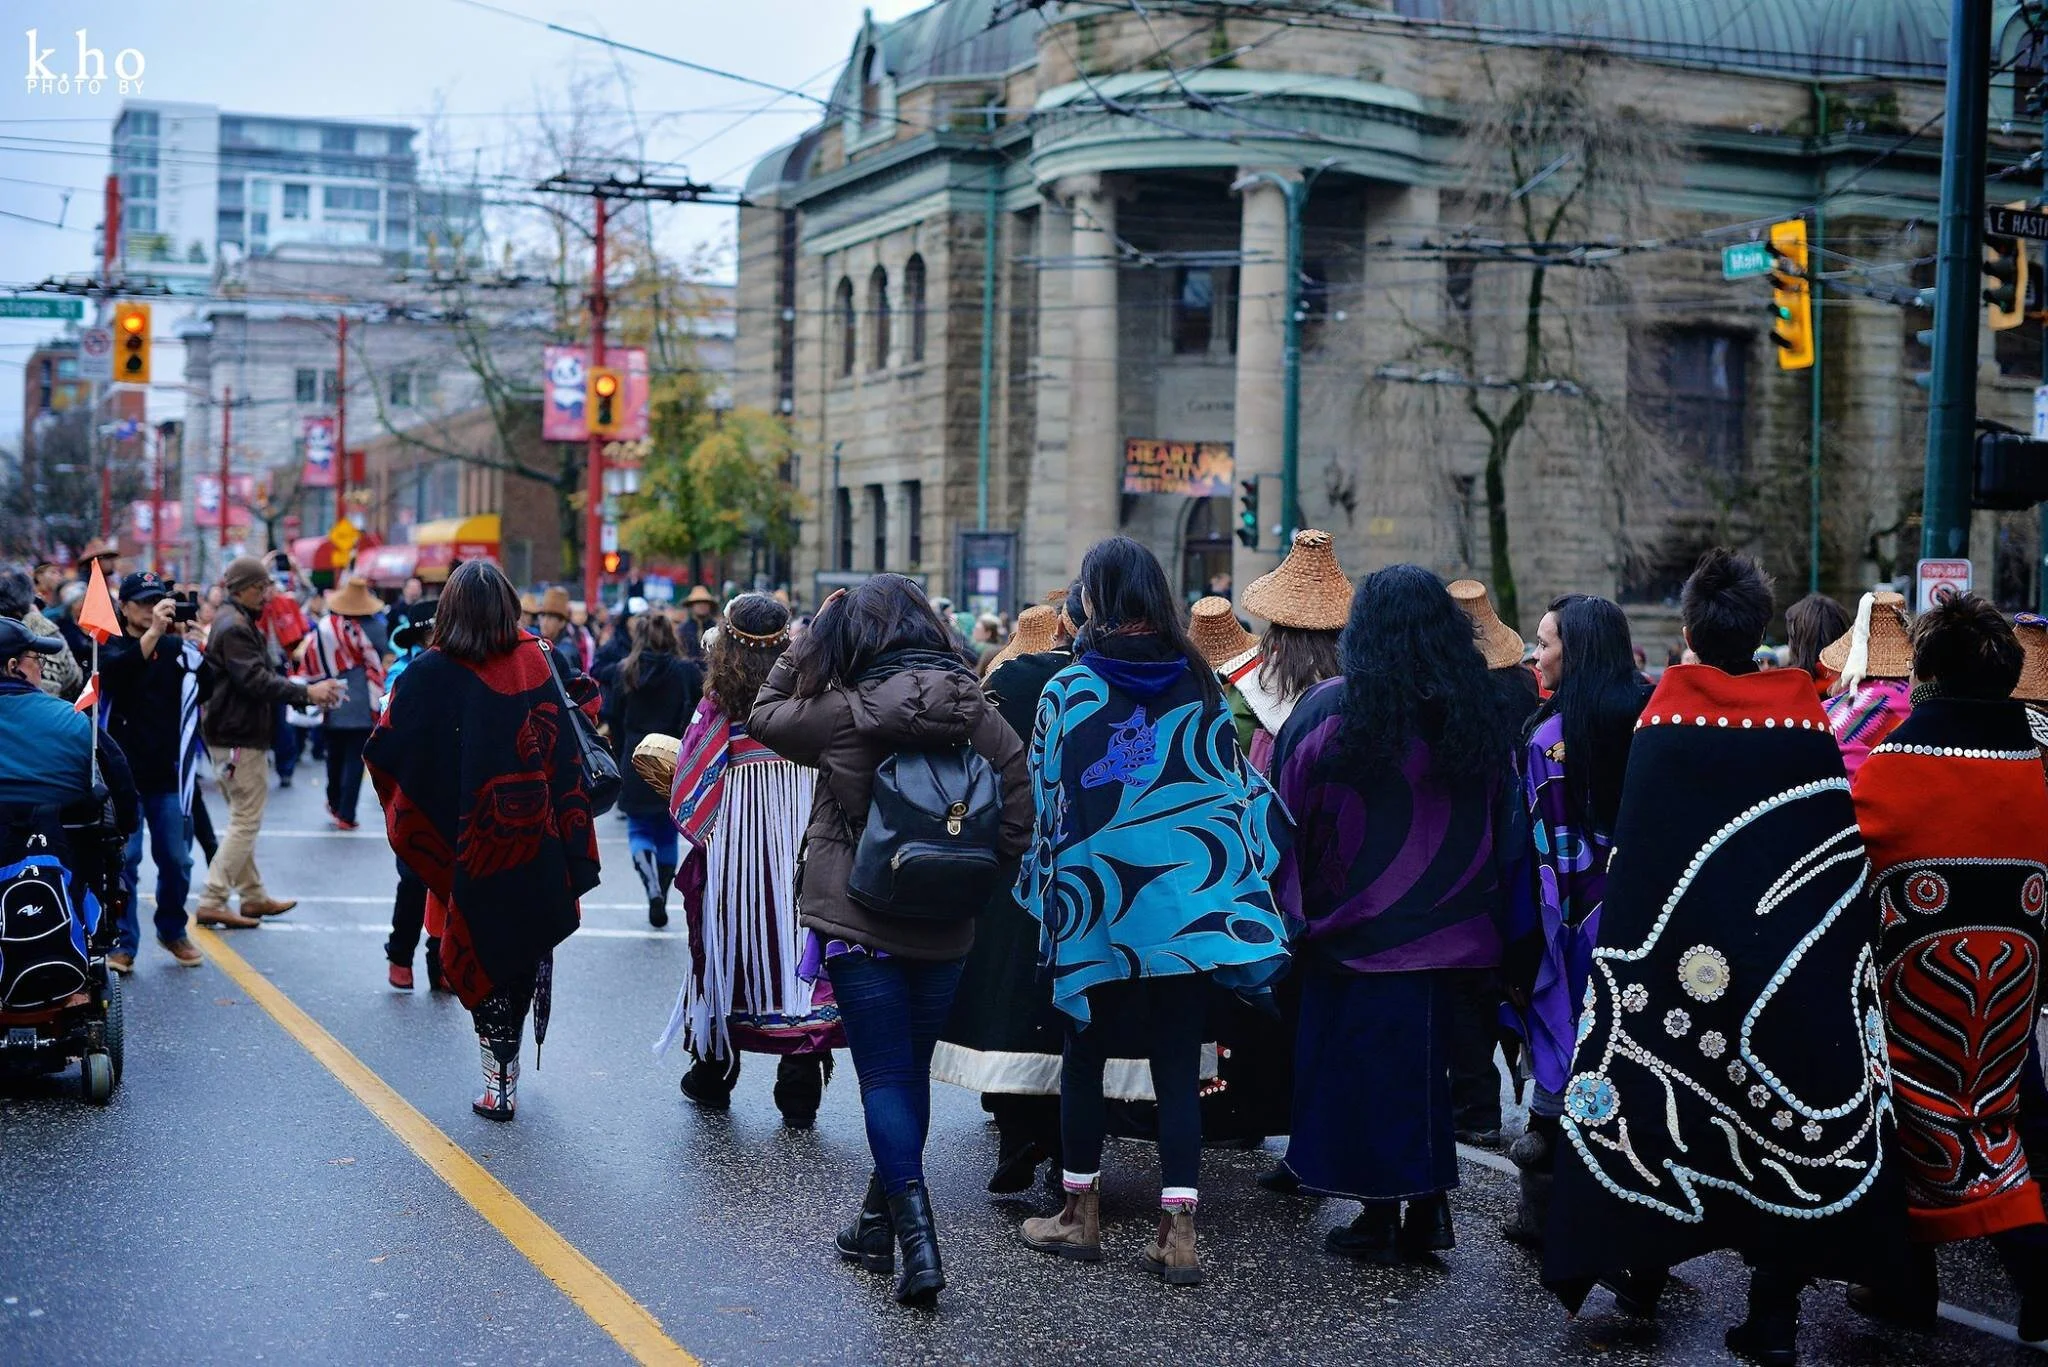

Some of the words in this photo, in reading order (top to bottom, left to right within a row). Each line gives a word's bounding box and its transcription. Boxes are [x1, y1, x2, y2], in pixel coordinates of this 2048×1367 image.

[1998, 211, 2005, 231] E
[1730, 251, 1763, 271] Main
[1127, 444, 1194, 463] HEART
